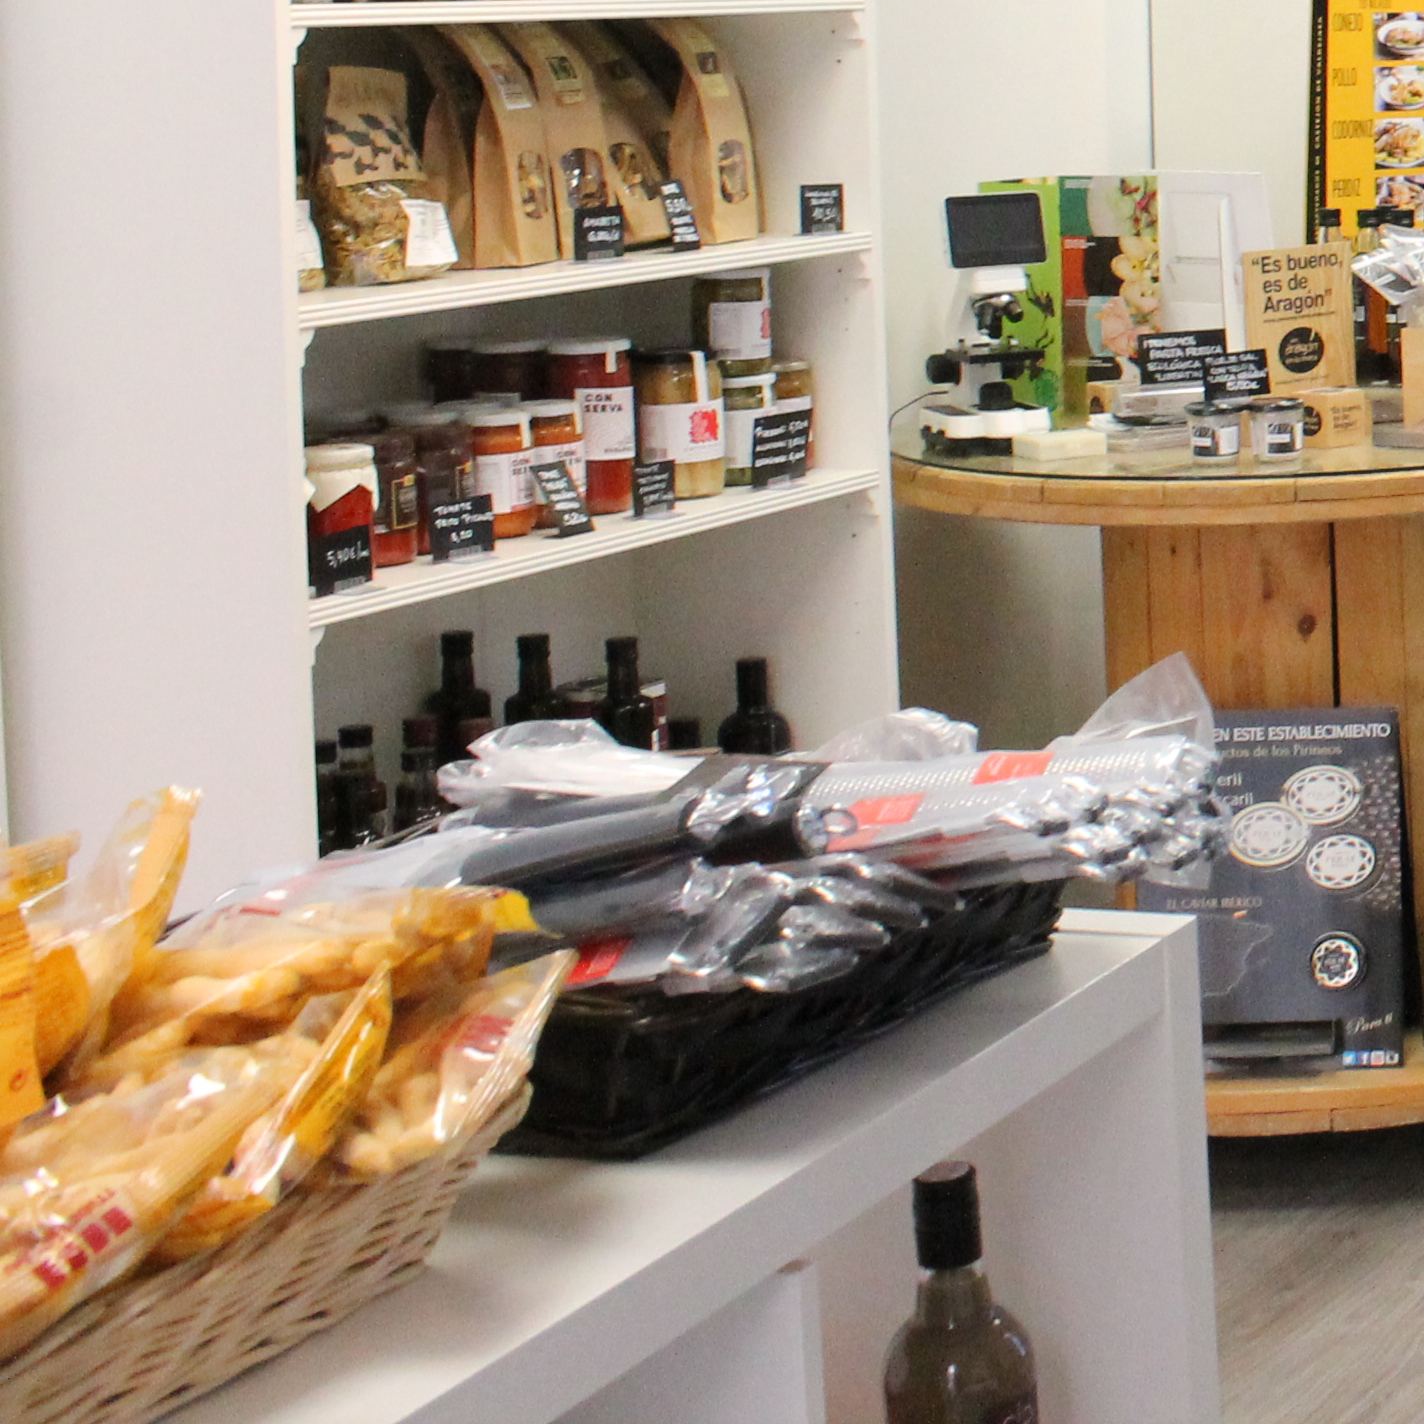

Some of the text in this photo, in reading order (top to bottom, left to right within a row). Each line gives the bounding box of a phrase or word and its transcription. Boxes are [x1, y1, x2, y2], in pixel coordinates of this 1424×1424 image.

[1331, 67, 1358, 87] POLLO
[1331, 178, 1361, 198] PERDIZ
[1287, 253, 1344, 270] bueno,
[1262, 274, 1309, 294] es de
[1232, 727, 1266, 742] ESTE
[1267, 722, 1392, 741] ESTABLECIMIENTO
